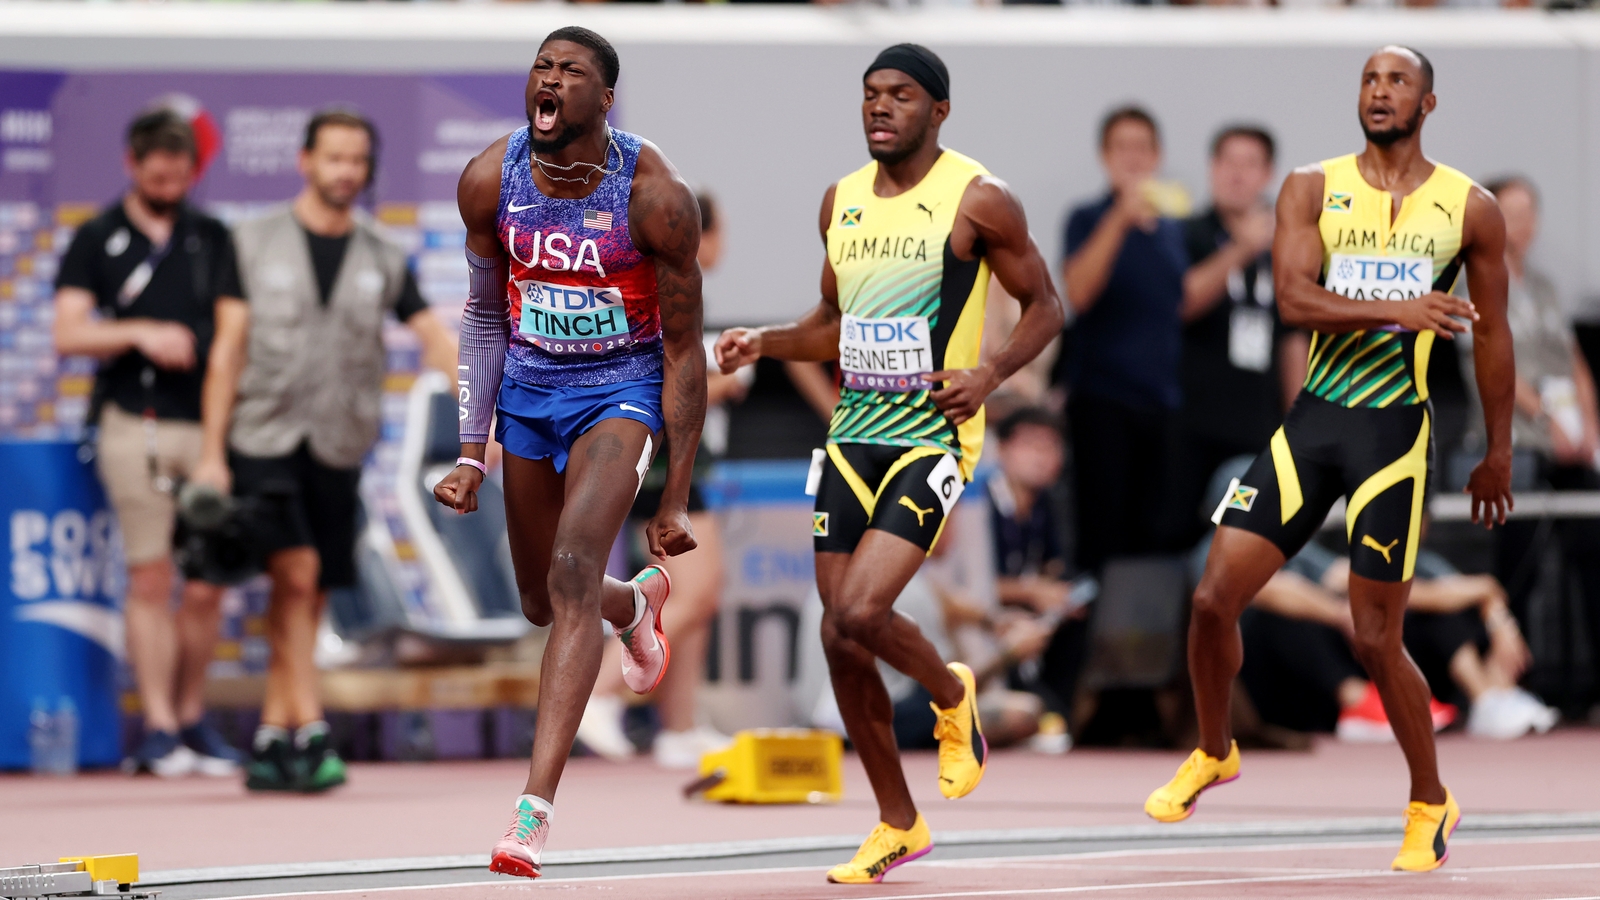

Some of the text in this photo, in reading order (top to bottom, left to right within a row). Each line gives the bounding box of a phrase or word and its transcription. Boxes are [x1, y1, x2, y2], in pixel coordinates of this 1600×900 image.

[508, 226, 606, 278] USA
[835, 237, 927, 265] JAMAICA
[1333, 228, 1436, 257] JAMAICA
[1355, 260, 1423, 283] TDK
[542, 285, 614, 310] TDK
[530, 308, 617, 337] TINCH
[856, 321, 919, 343] TDK
[844, 346, 925, 371] BENNETT
[941, 475, 956, 500] 6
